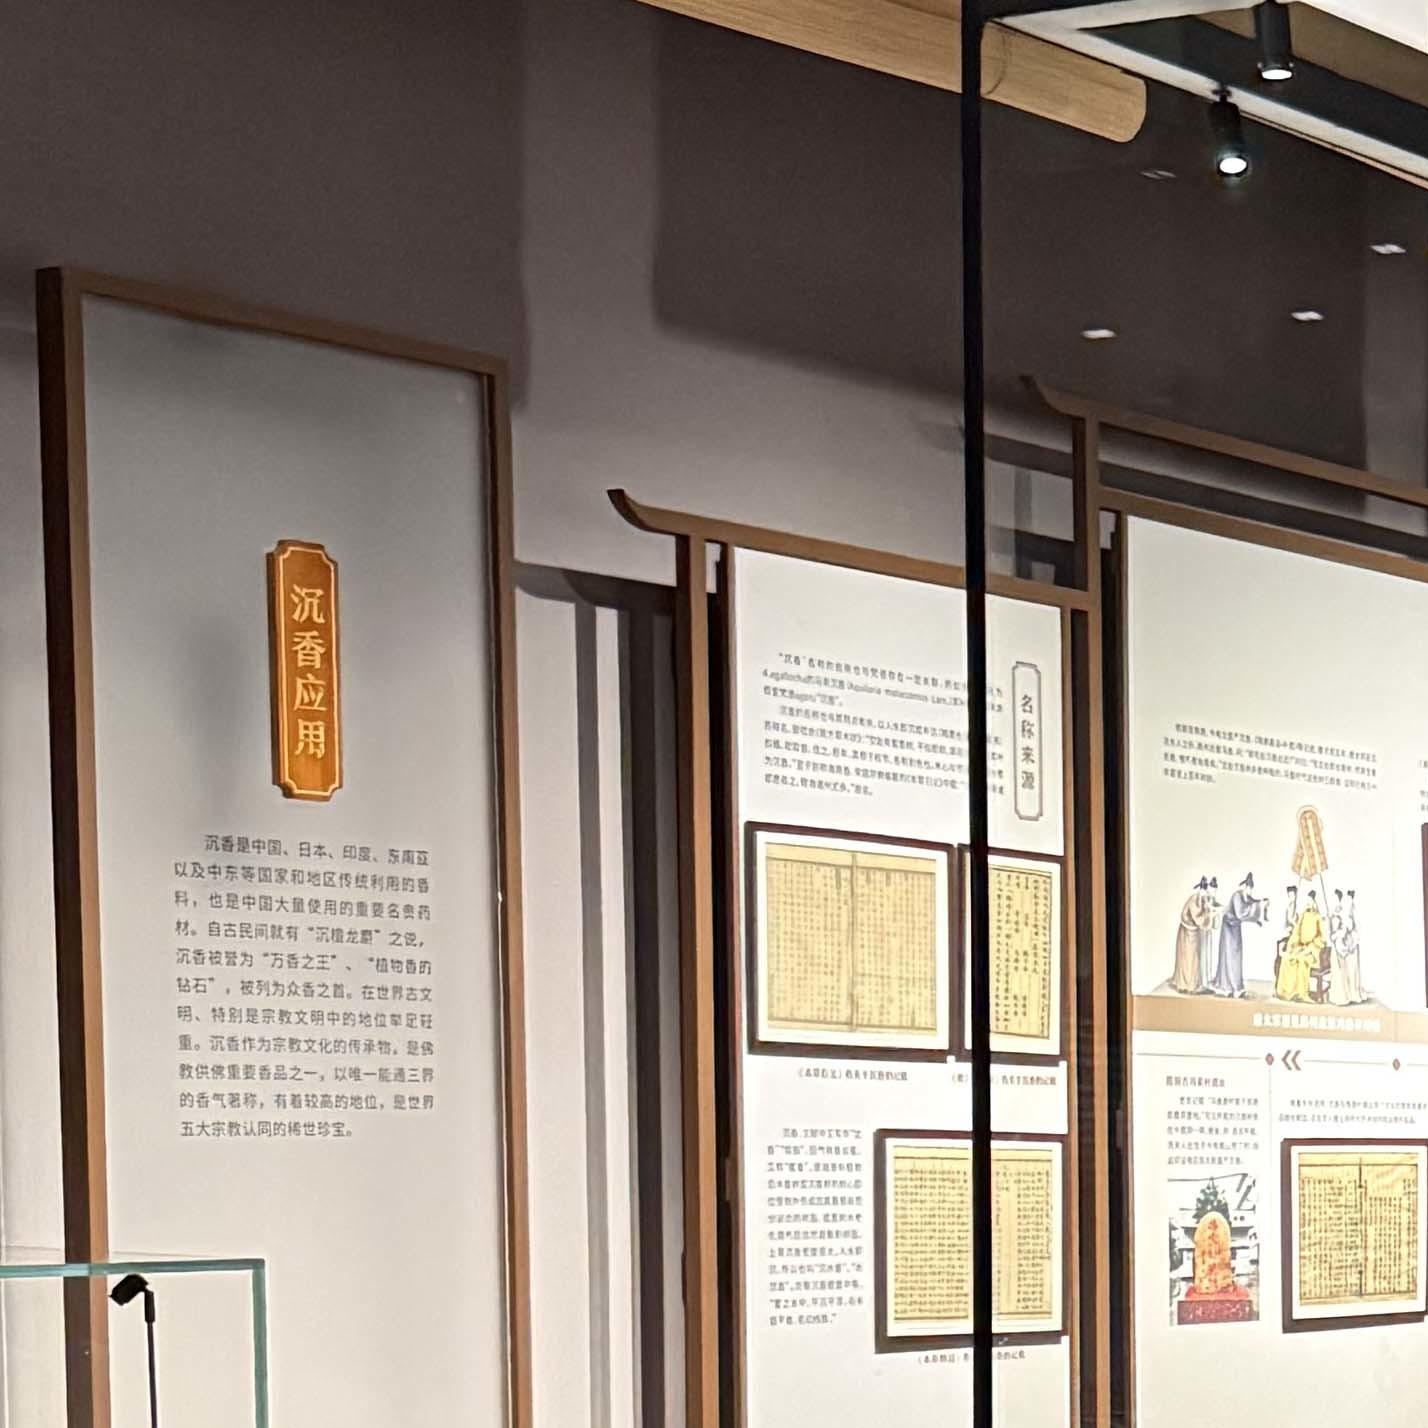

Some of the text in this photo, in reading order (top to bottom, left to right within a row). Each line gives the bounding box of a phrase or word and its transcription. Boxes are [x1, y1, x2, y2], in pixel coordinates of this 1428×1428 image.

[290, 583, 328, 761] 沉香应用
[1020, 693, 1036, 791] 名称来源
